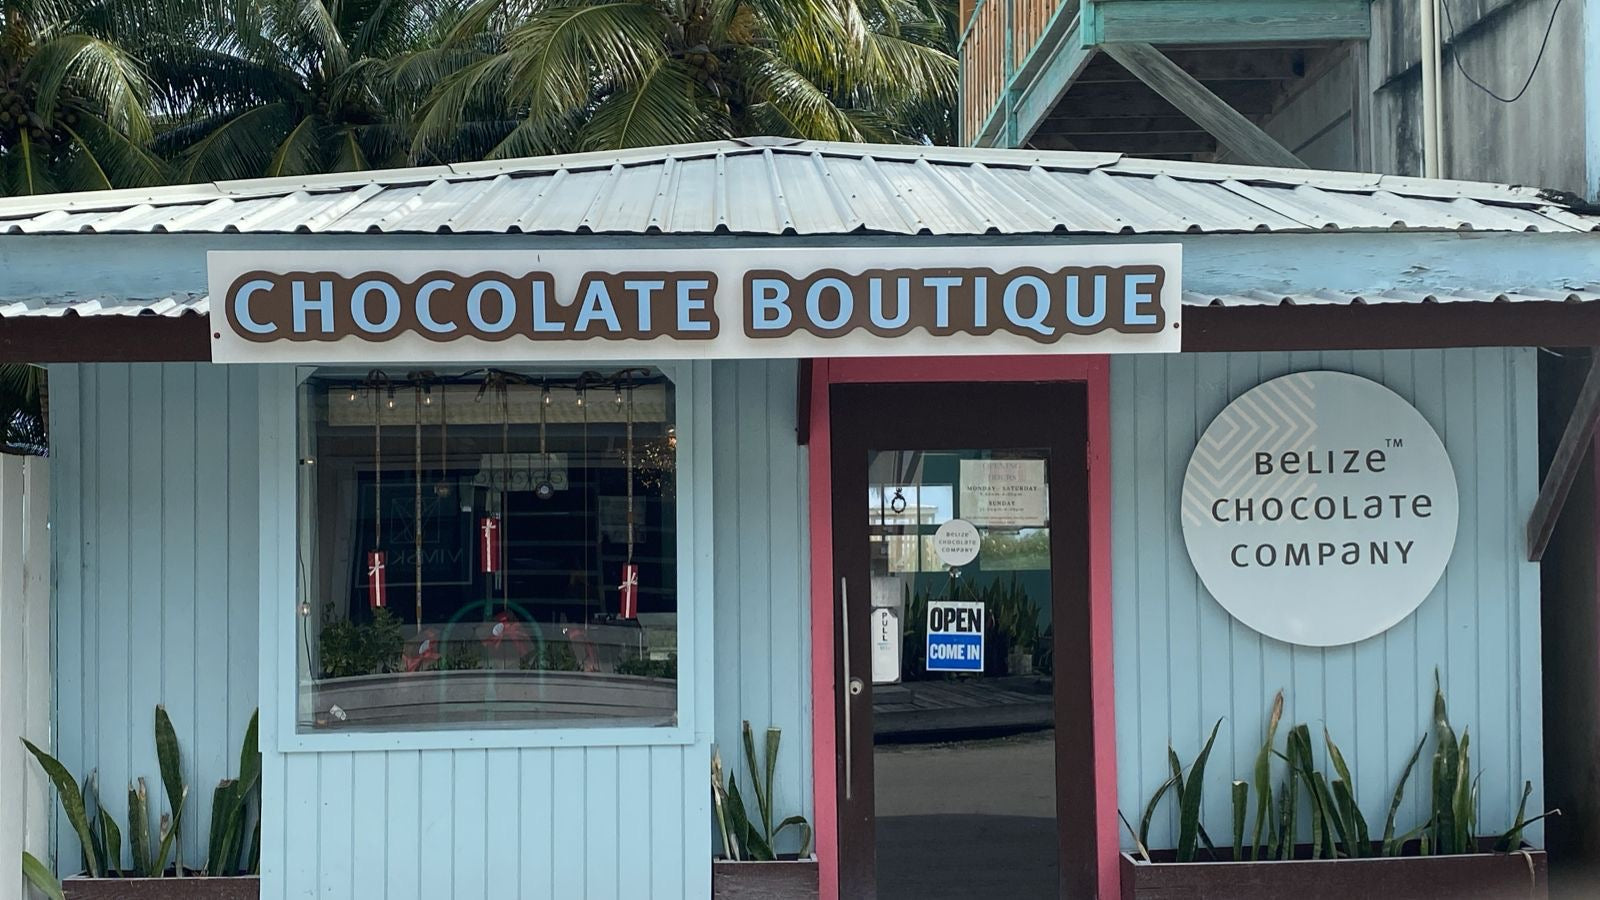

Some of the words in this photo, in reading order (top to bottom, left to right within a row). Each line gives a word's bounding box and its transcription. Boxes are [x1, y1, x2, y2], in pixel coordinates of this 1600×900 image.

[234, 278, 712, 335] CHOCOLATE
[751, 273, 1158, 336] BOUTIQUE
[929, 606, 982, 633] OPEN
[929, 643, 965, 660] COME
[967, 644, 980, 661] IN
